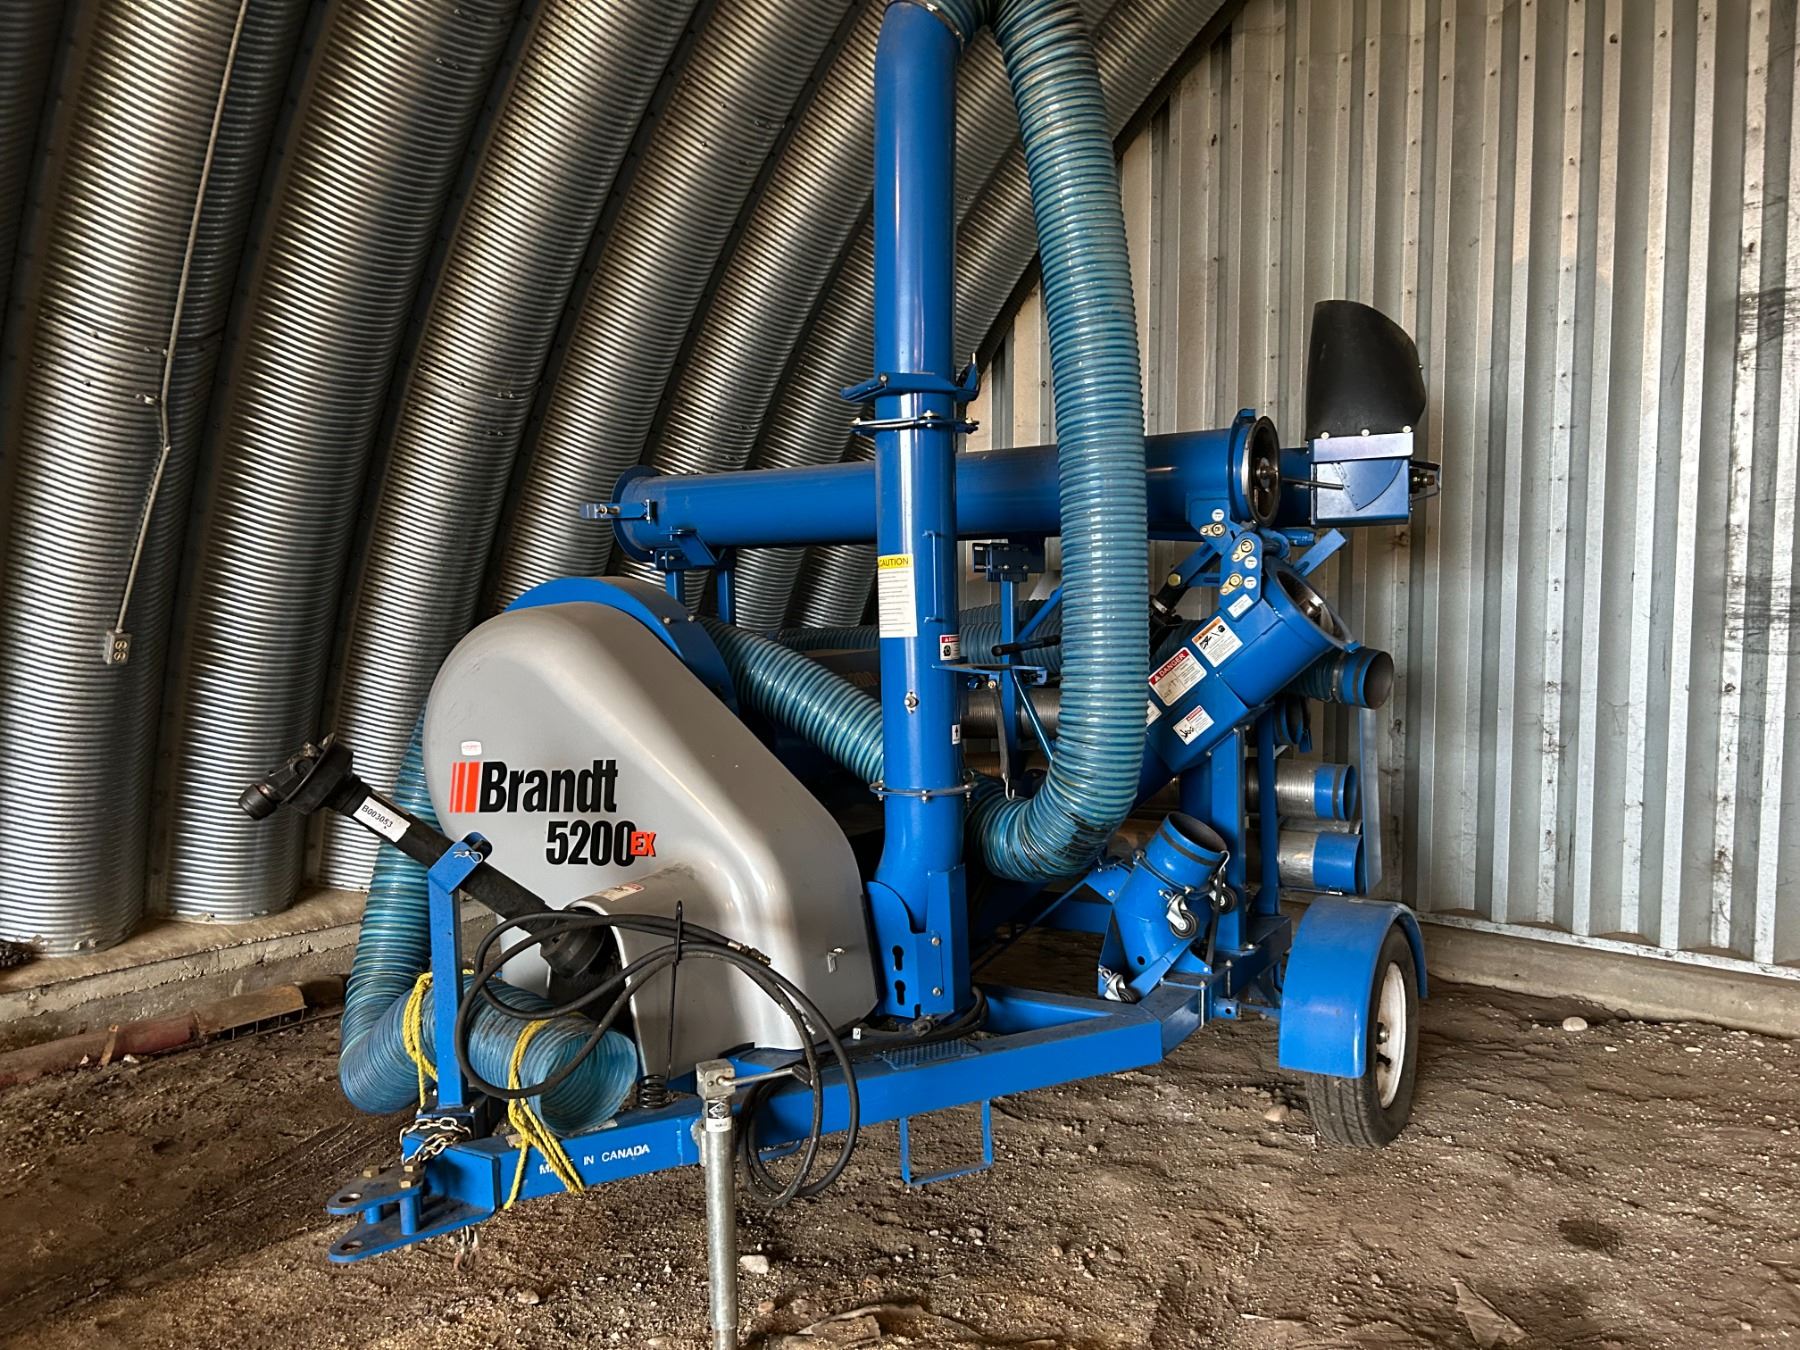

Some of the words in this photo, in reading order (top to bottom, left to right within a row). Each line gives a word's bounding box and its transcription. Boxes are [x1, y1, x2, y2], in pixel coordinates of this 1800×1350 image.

[879, 557, 909, 567] CAUTION
[1159, 652, 1186, 677] DANGER
[479, 759, 618, 813] Brandt
[361, 804, 394, 828] B003053
[583, 1155, 595, 1166] IN
[601, 1143, 651, 1162] CANADA
